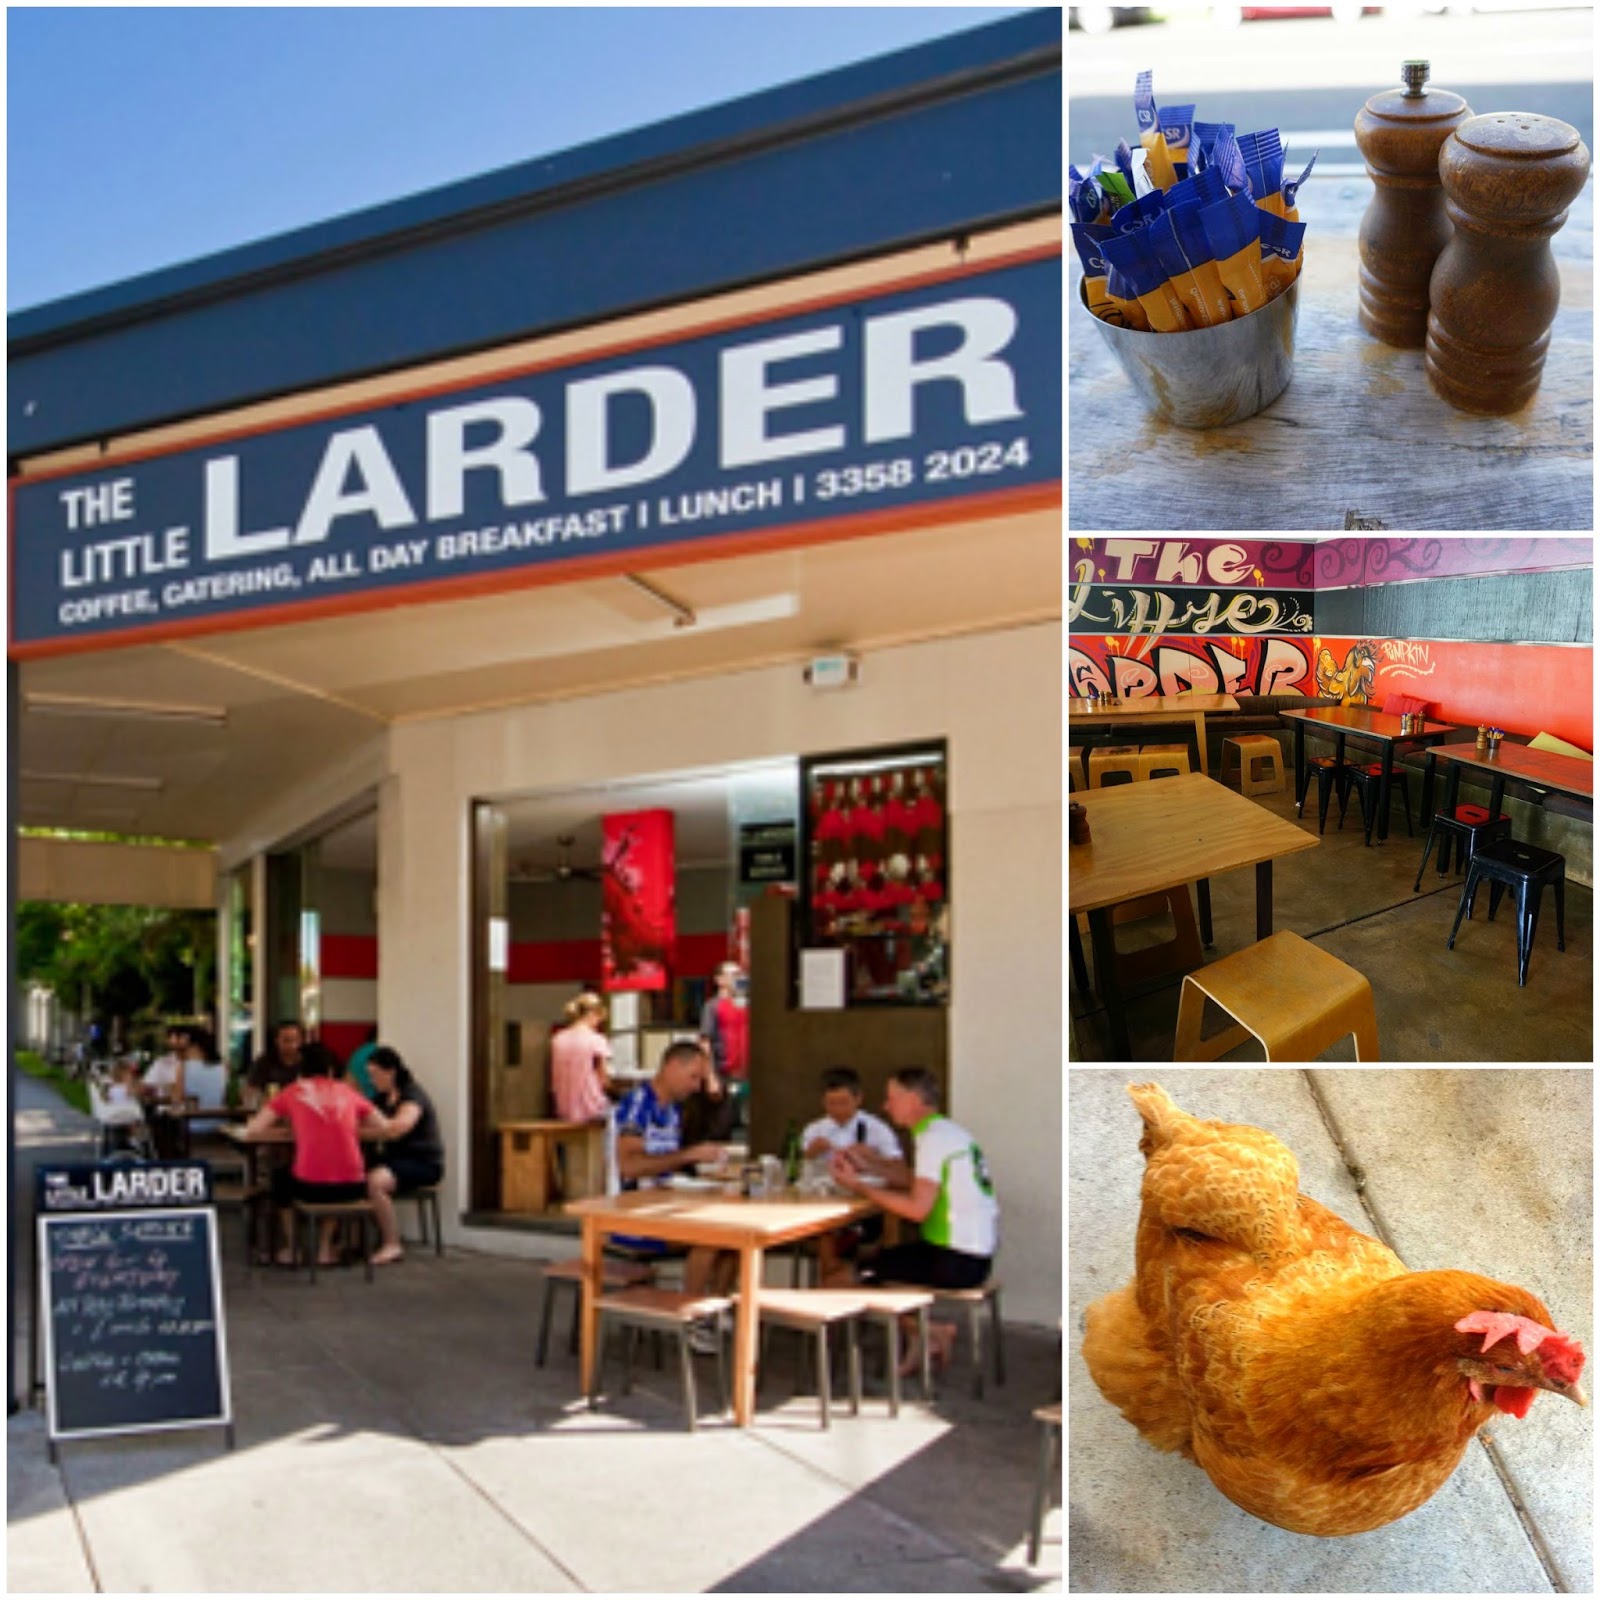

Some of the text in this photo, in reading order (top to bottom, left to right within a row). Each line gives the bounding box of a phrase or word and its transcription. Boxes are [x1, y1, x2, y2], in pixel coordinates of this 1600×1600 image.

[1161, 127, 1181, 140] SR
[1120, 213, 1155, 234] CSR
[205, 296, 1026, 561] LARDER
[58, 591, 159, 625] COFFEE,
[162, 563, 303, 609] CATERING,
[307, 544, 361, 583] ALL
[369, 537, 428, 573] DAY
[436, 504, 628, 561] BREAKFAST
[658, 477, 782, 524] LUNCH
[816, 458, 913, 500] 3358
[924, 437, 1030, 484] 2024
[60, 478, 133, 530] THE
[61, 526, 190, 589] LITTLE
[1069, 638, 1308, 698] ARDER
[94, 1167, 206, 1201] LARDER
